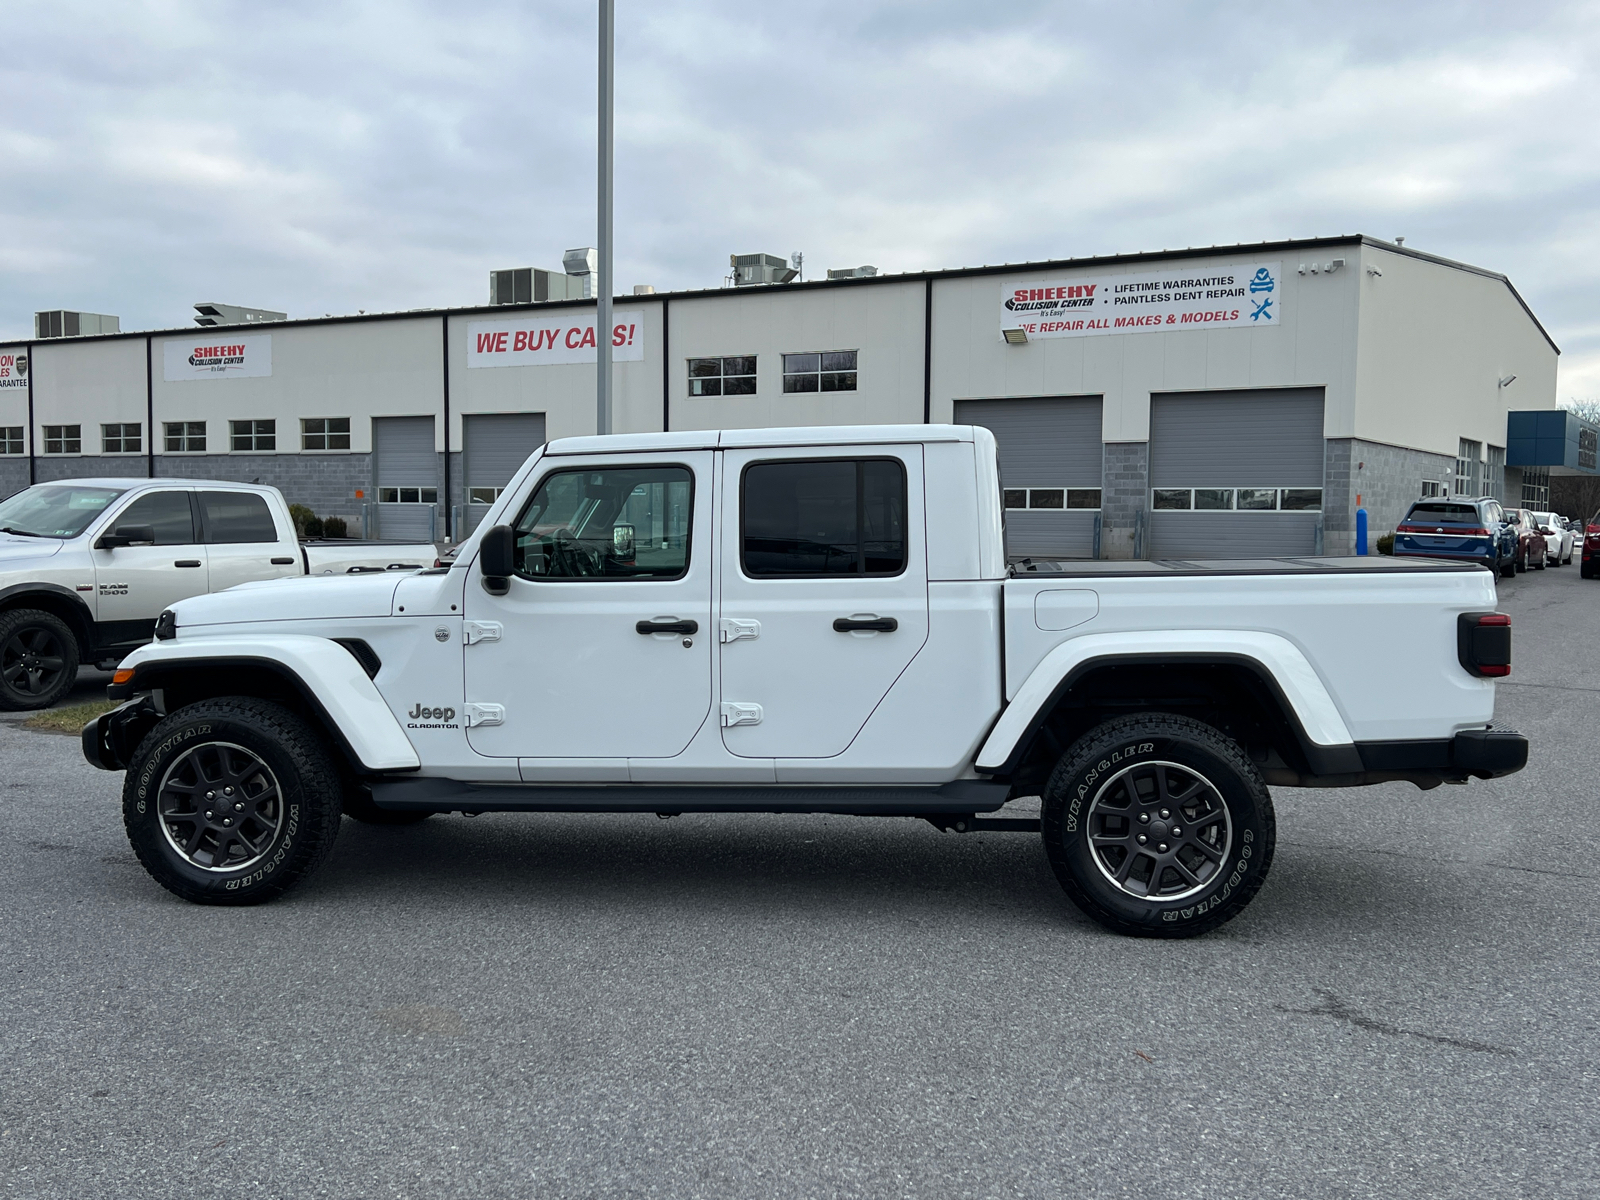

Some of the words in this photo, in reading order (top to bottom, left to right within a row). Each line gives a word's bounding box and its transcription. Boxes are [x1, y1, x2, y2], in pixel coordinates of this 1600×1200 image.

[1014, 284, 1097, 302] SHEEHY
[1114, 281, 1160, 294] LIFETIME
[1163, 276, 1234, 289] WARRANTIES
[1014, 300, 1060, 312] COLLISION
[1060, 298, 1095, 309] CENTER
[1114, 293, 1171, 306] PAINTLESS
[1174, 291, 1204, 301] DENT
[1206, 287, 1246, 299] REPAIR
[1040, 309, 1049, 317] It's
[1049, 309, 1066, 317] Easy!
[1040, 320, 1084, 333] REPAIR
[1086, 318, 1110, 329] ALL
[1114, 314, 1162, 328] MAKES
[1165, 314, 1176, 325] &
[1180, 309, 1239, 324] MODELS
[477, 332, 509, 354] WE
[513, 329, 561, 352] BUY
[565, 324, 636, 350] CAS!
[194, 344, 246, 358] SHEEHY
[194, 358, 222, 367] COLLISION
[223, 357, 245, 365] CENTER
[408, 703, 456, 722] Jeep
[137, 725, 211, 814] GOODYEAR
[1067, 743, 1154, 831] WRANGLER
[226, 804, 299, 890] WRANGLER
[1162, 829, 1254, 921] GOODYEAR
